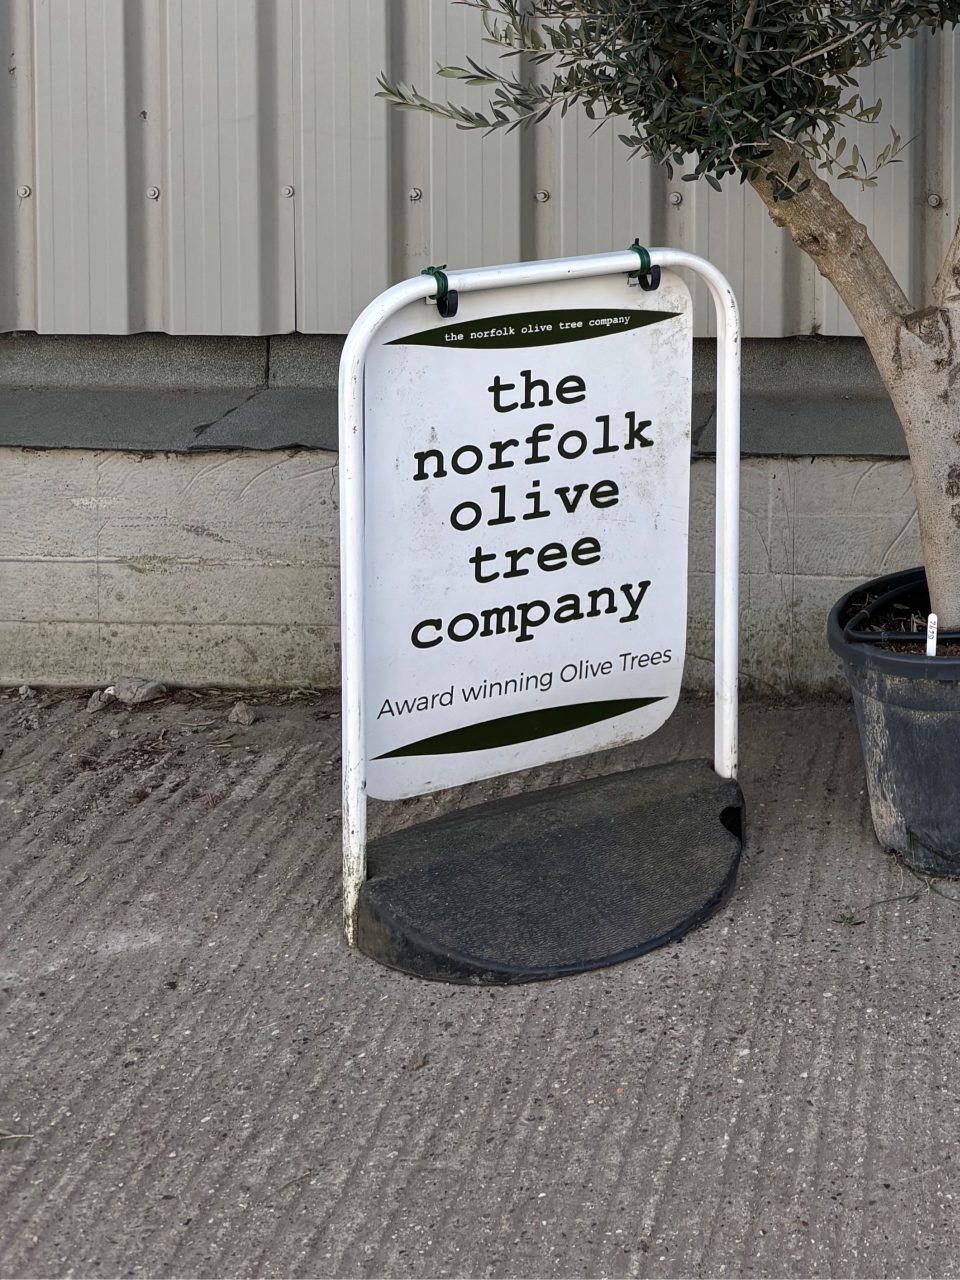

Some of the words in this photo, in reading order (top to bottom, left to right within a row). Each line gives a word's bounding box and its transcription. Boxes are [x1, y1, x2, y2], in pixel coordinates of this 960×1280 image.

[444, 331, 464, 342] the
[470, 325, 516, 340] norfolk
[521, 322, 553, 334] olive
[559, 320, 583, 331] tree
[588, 315, 631, 328] company
[487, 370, 586, 413] the
[413, 411, 655, 481] norfolk
[450, 479, 619, 531] olive
[468, 536, 601, 584] tree
[410, 579, 652, 649] company
[376, 685, 454, 720] Award
[461, 671, 553, 703] winning
[559, 660, 613, 683] Olive
[619, 648, 672, 672] Trees
